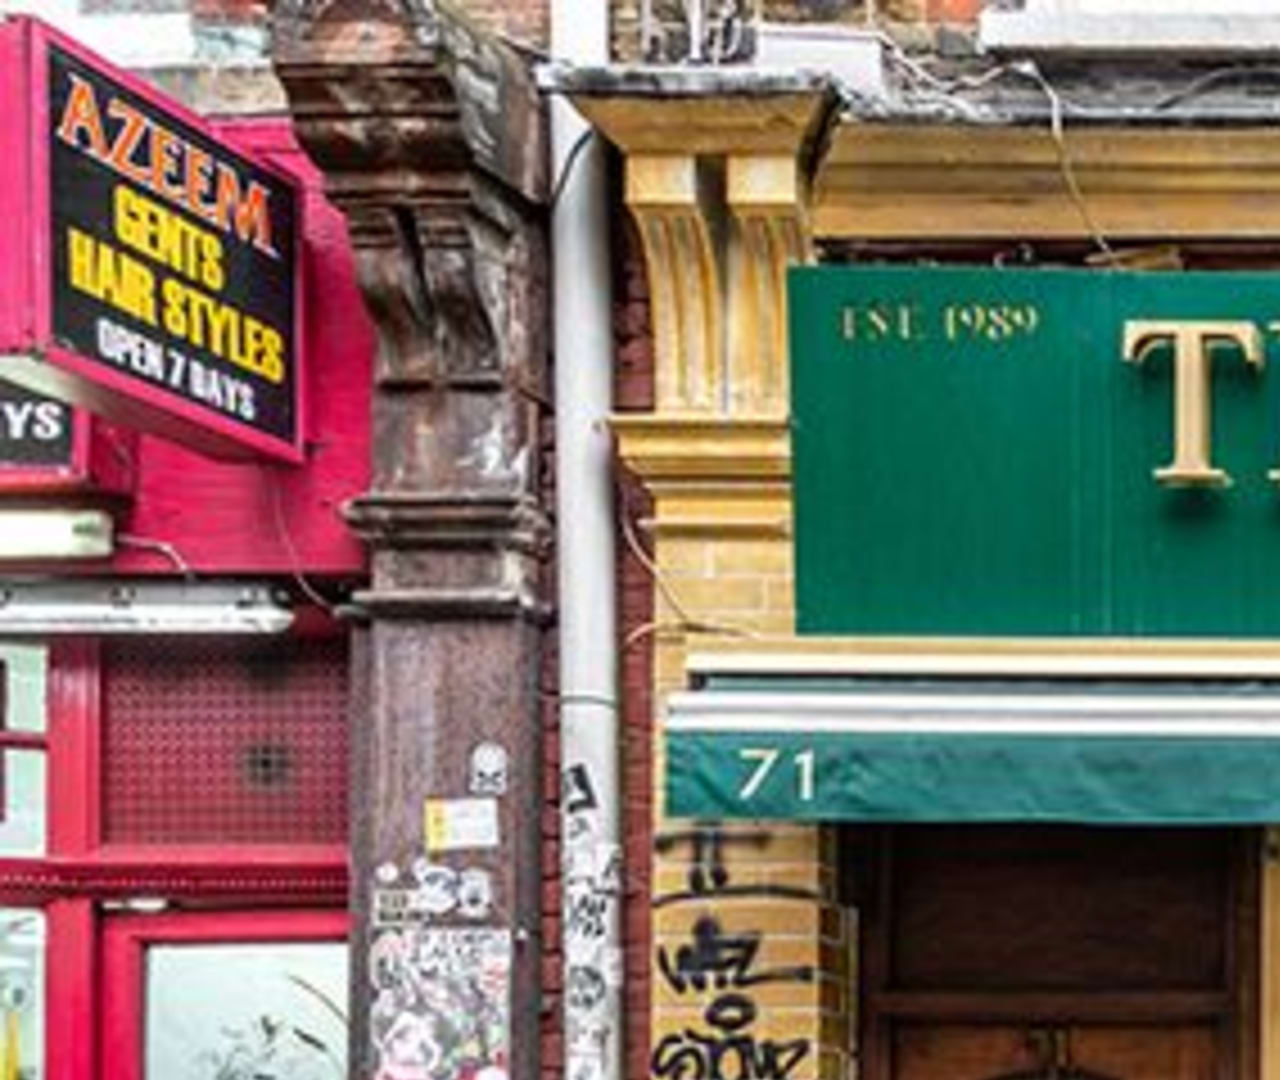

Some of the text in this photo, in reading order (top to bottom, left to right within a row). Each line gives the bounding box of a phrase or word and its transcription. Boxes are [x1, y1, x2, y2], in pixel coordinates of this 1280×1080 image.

[56, 72, 280, 259] AZEEM
[114, 184, 225, 291] GENTS
[67, 226, 284, 385] HAIR STYLES
[944, 303, 1039, 341] 1989
[97, 318, 255, 421] OPEN 7 DAYS
[738, 747, 814, 800] 71
